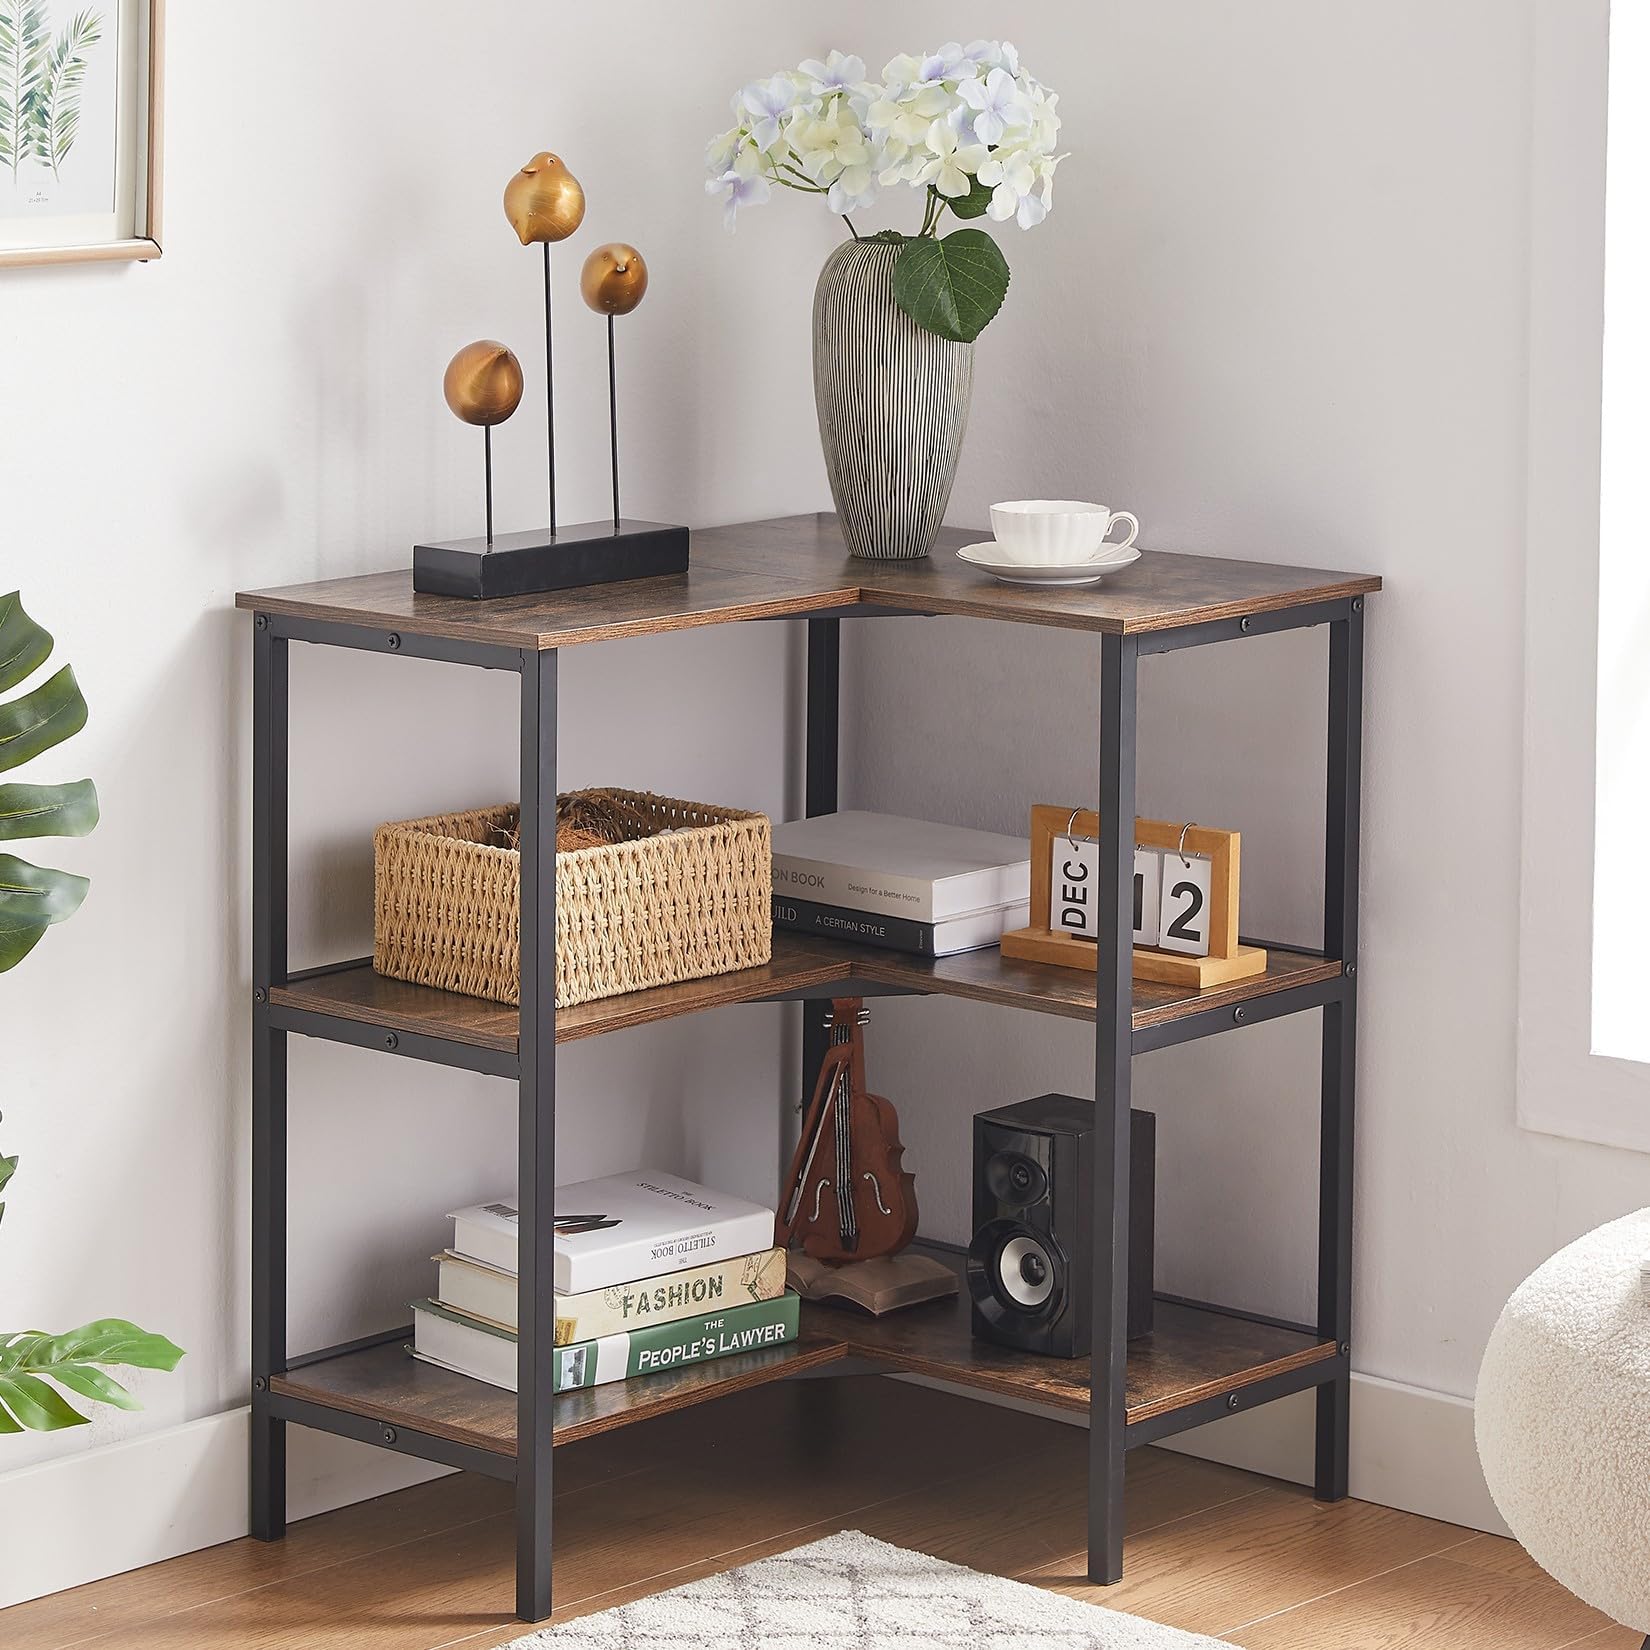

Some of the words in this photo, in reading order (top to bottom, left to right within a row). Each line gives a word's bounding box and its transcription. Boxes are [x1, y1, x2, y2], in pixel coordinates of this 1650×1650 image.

[791, 871, 825, 889] BOOK
[847, 883, 868, 895] Design
[869, 887, 878, 895] for
[883, 890, 901, 900] Better
[902, 893, 921, 904] Home
[1061, 860, 1089, 930] DEC
[1166, 881, 1204, 942] 2
[815, 915, 822, 925] A
[823, 916, 858, 932] CERTIAN
[859, 923, 886, 937] STYLE
[650, 1245, 675, 1260] BOOK
[677, 1235, 716, 1254] STILETTO
[622, 1274, 724, 1319] FASHION
[704, 1318, 725, 1331] THE
[638, 1336, 716, 1371] PEOPLE'S
[719, 1322, 786, 1352] LAWYER
